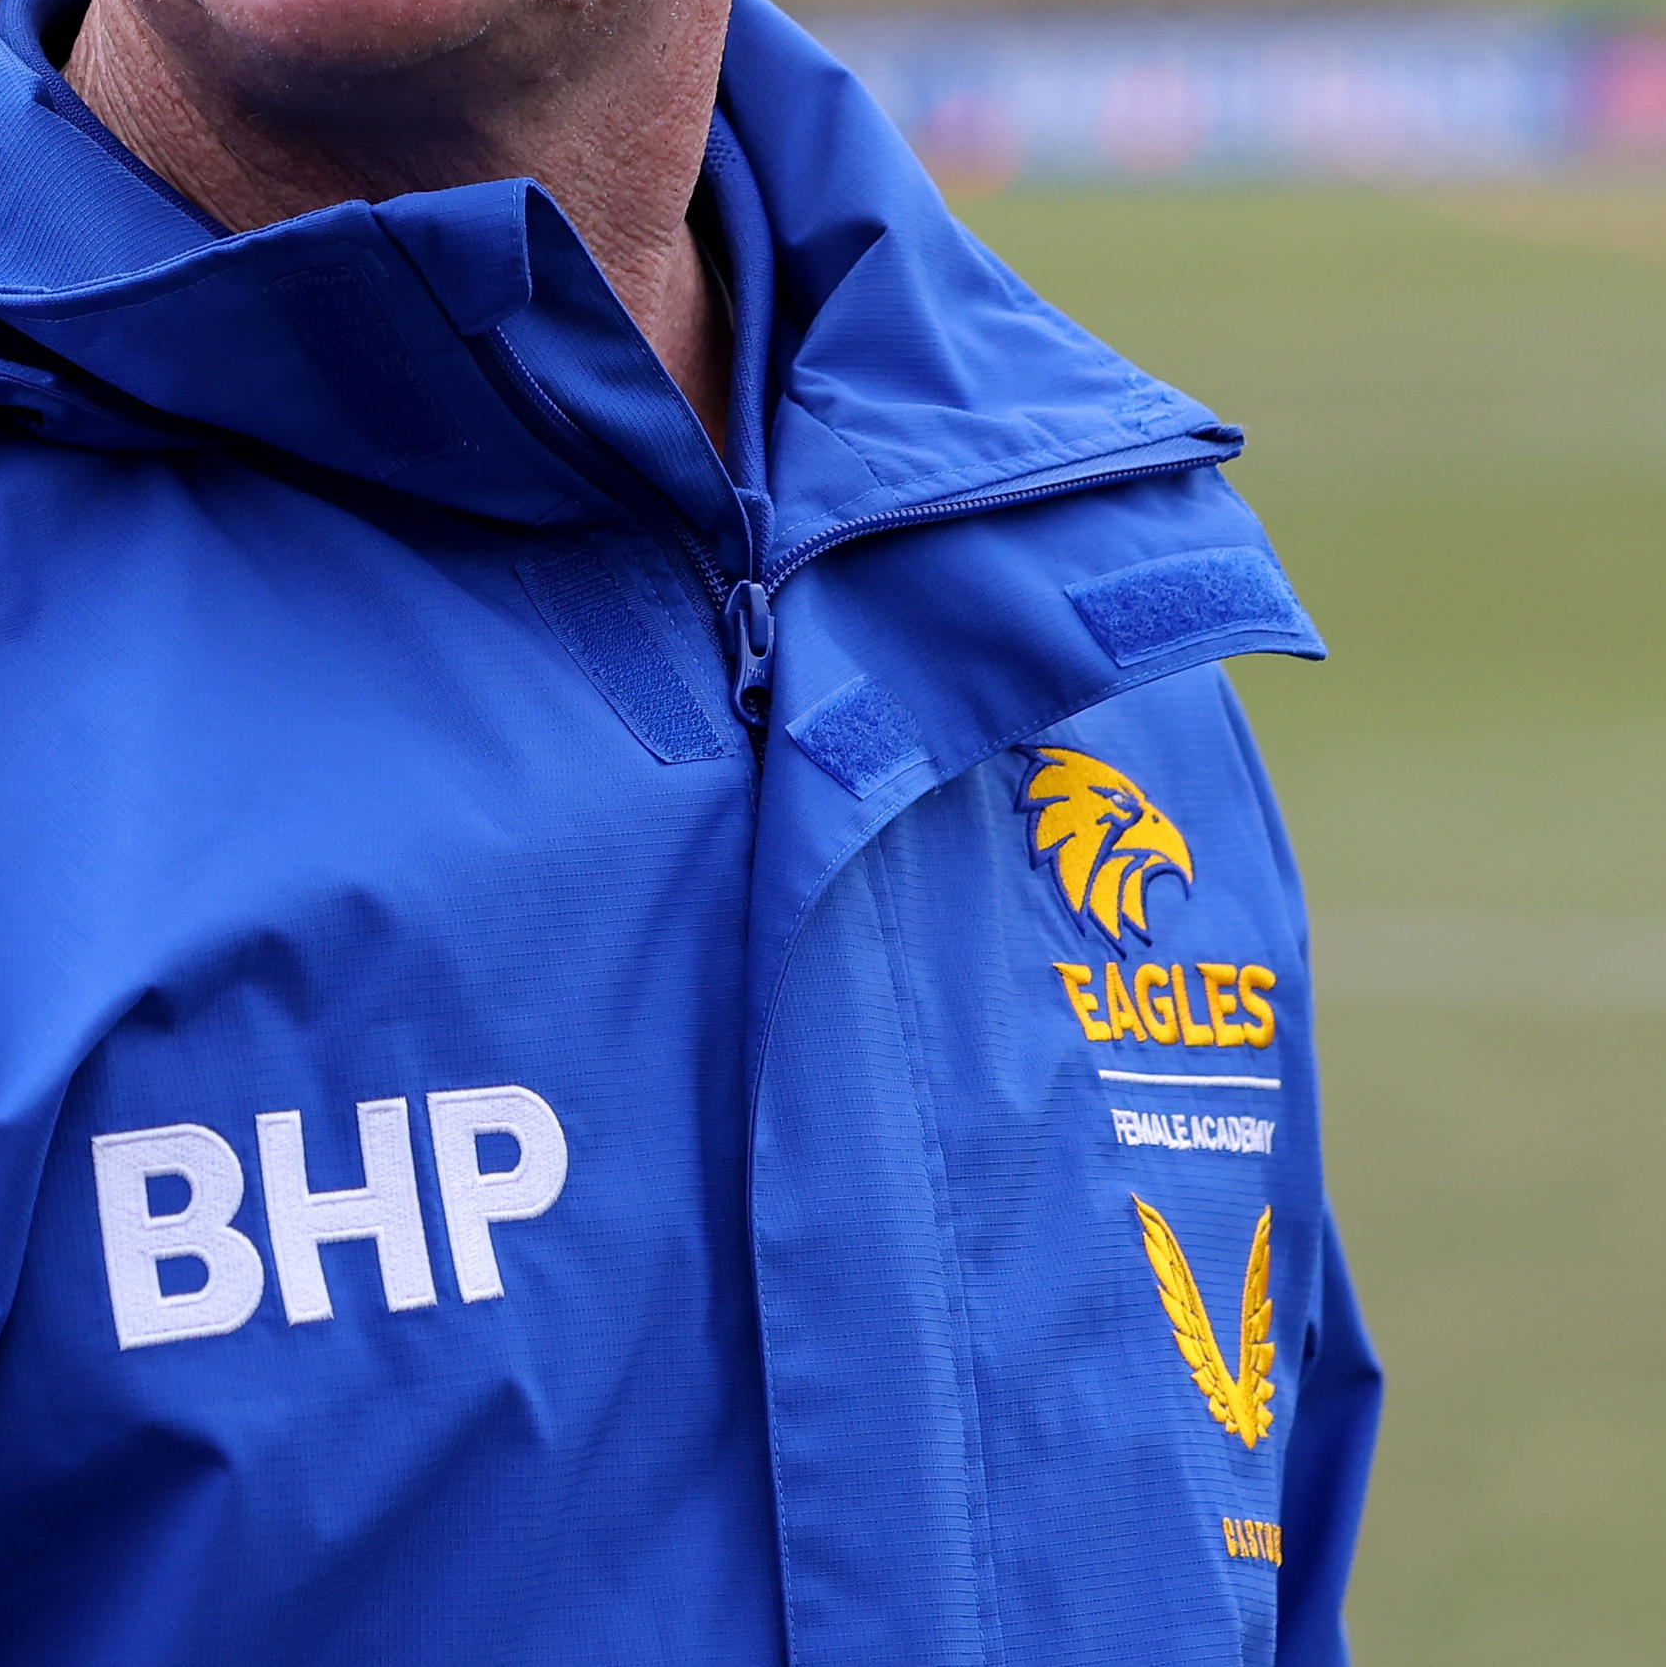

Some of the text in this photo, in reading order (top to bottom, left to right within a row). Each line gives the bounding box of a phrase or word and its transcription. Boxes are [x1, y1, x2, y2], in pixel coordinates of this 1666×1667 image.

[1053, 962, 1276, 1049] EAGLES
[1111, 1109, 1275, 1154] FEMALE ACADEMY
[90, 1085, 568, 1351] BHP
